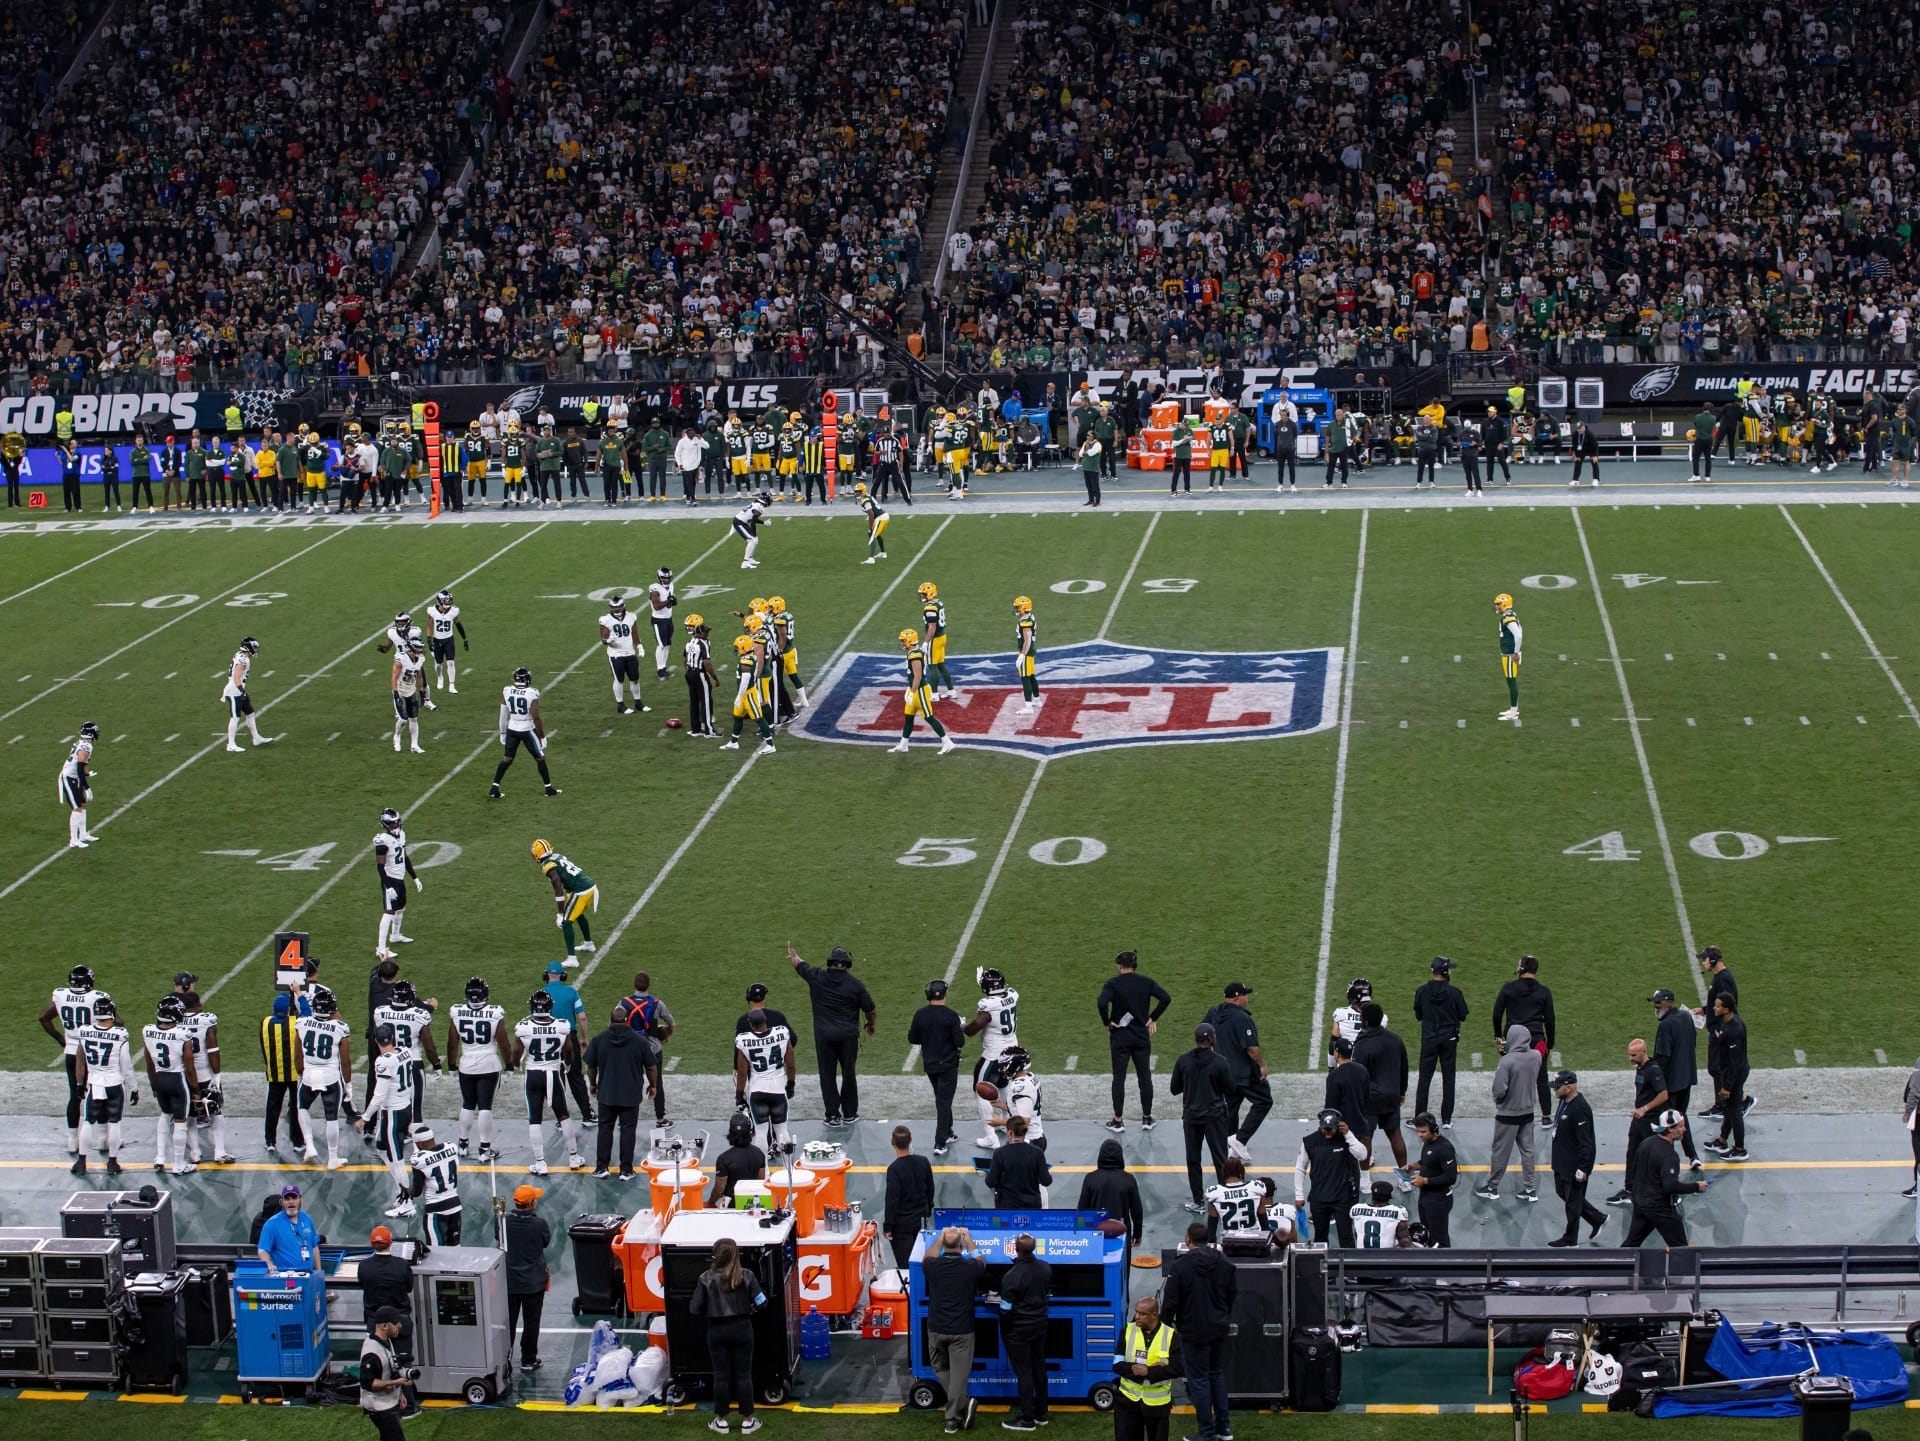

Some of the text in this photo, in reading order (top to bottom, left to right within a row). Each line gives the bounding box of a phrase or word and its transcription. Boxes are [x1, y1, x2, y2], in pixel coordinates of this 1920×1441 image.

[0, 396, 56, 434] GO
[878, 405, 890, 421] 4
[730, 437, 742, 448] 24
[1213, 429, 1226, 442] 44
[468, 440, 482, 451] 94
[508, 446, 519, 456] 21
[30, 493, 43, 506] 20
[435, 619, 451, 632] 29
[508, 696, 528, 715] 19
[856, 686, 1272, 739] NFL
[280, 939, 304, 969] 4
[61, 1006, 91, 1031] 90
[381, 1011, 416, 1021] WILLIAMS
[1000, 1006, 1017, 1035] 97
[303, 1019, 336, 1032] JOHNSON
[459, 1020, 492, 1044] 59
[532, 1026, 557, 1035] BURKS
[145, 1030, 167, 1040] SMITH
[742, 1034, 775, 1047] TROTTER
[84, 1040, 113, 1066] 57
[303, 1031, 334, 1060] 48
[528, 1038, 561, 1061] 42
[156, 1043, 171, 1068] 3
[749, 1045, 784, 1072] 54
[425, 1147, 457, 1166] GAINWELL
[431, 1159, 457, 1194] 14
[1224, 1188, 1249, 1200] RICKS
[1220, 1199, 1256, 1231] 23
[1049, 1238, 1088, 1247] Microsoft
[1363, 1221, 1381, 1248] 8
[1049, 1247, 1080, 1256] Surface
[798, 1254, 832, 1301] G
[261, 1292, 303, 1301] Microsoft
[261, 1302, 294, 1310] Surface
[872, 1328, 880, 1337] G
